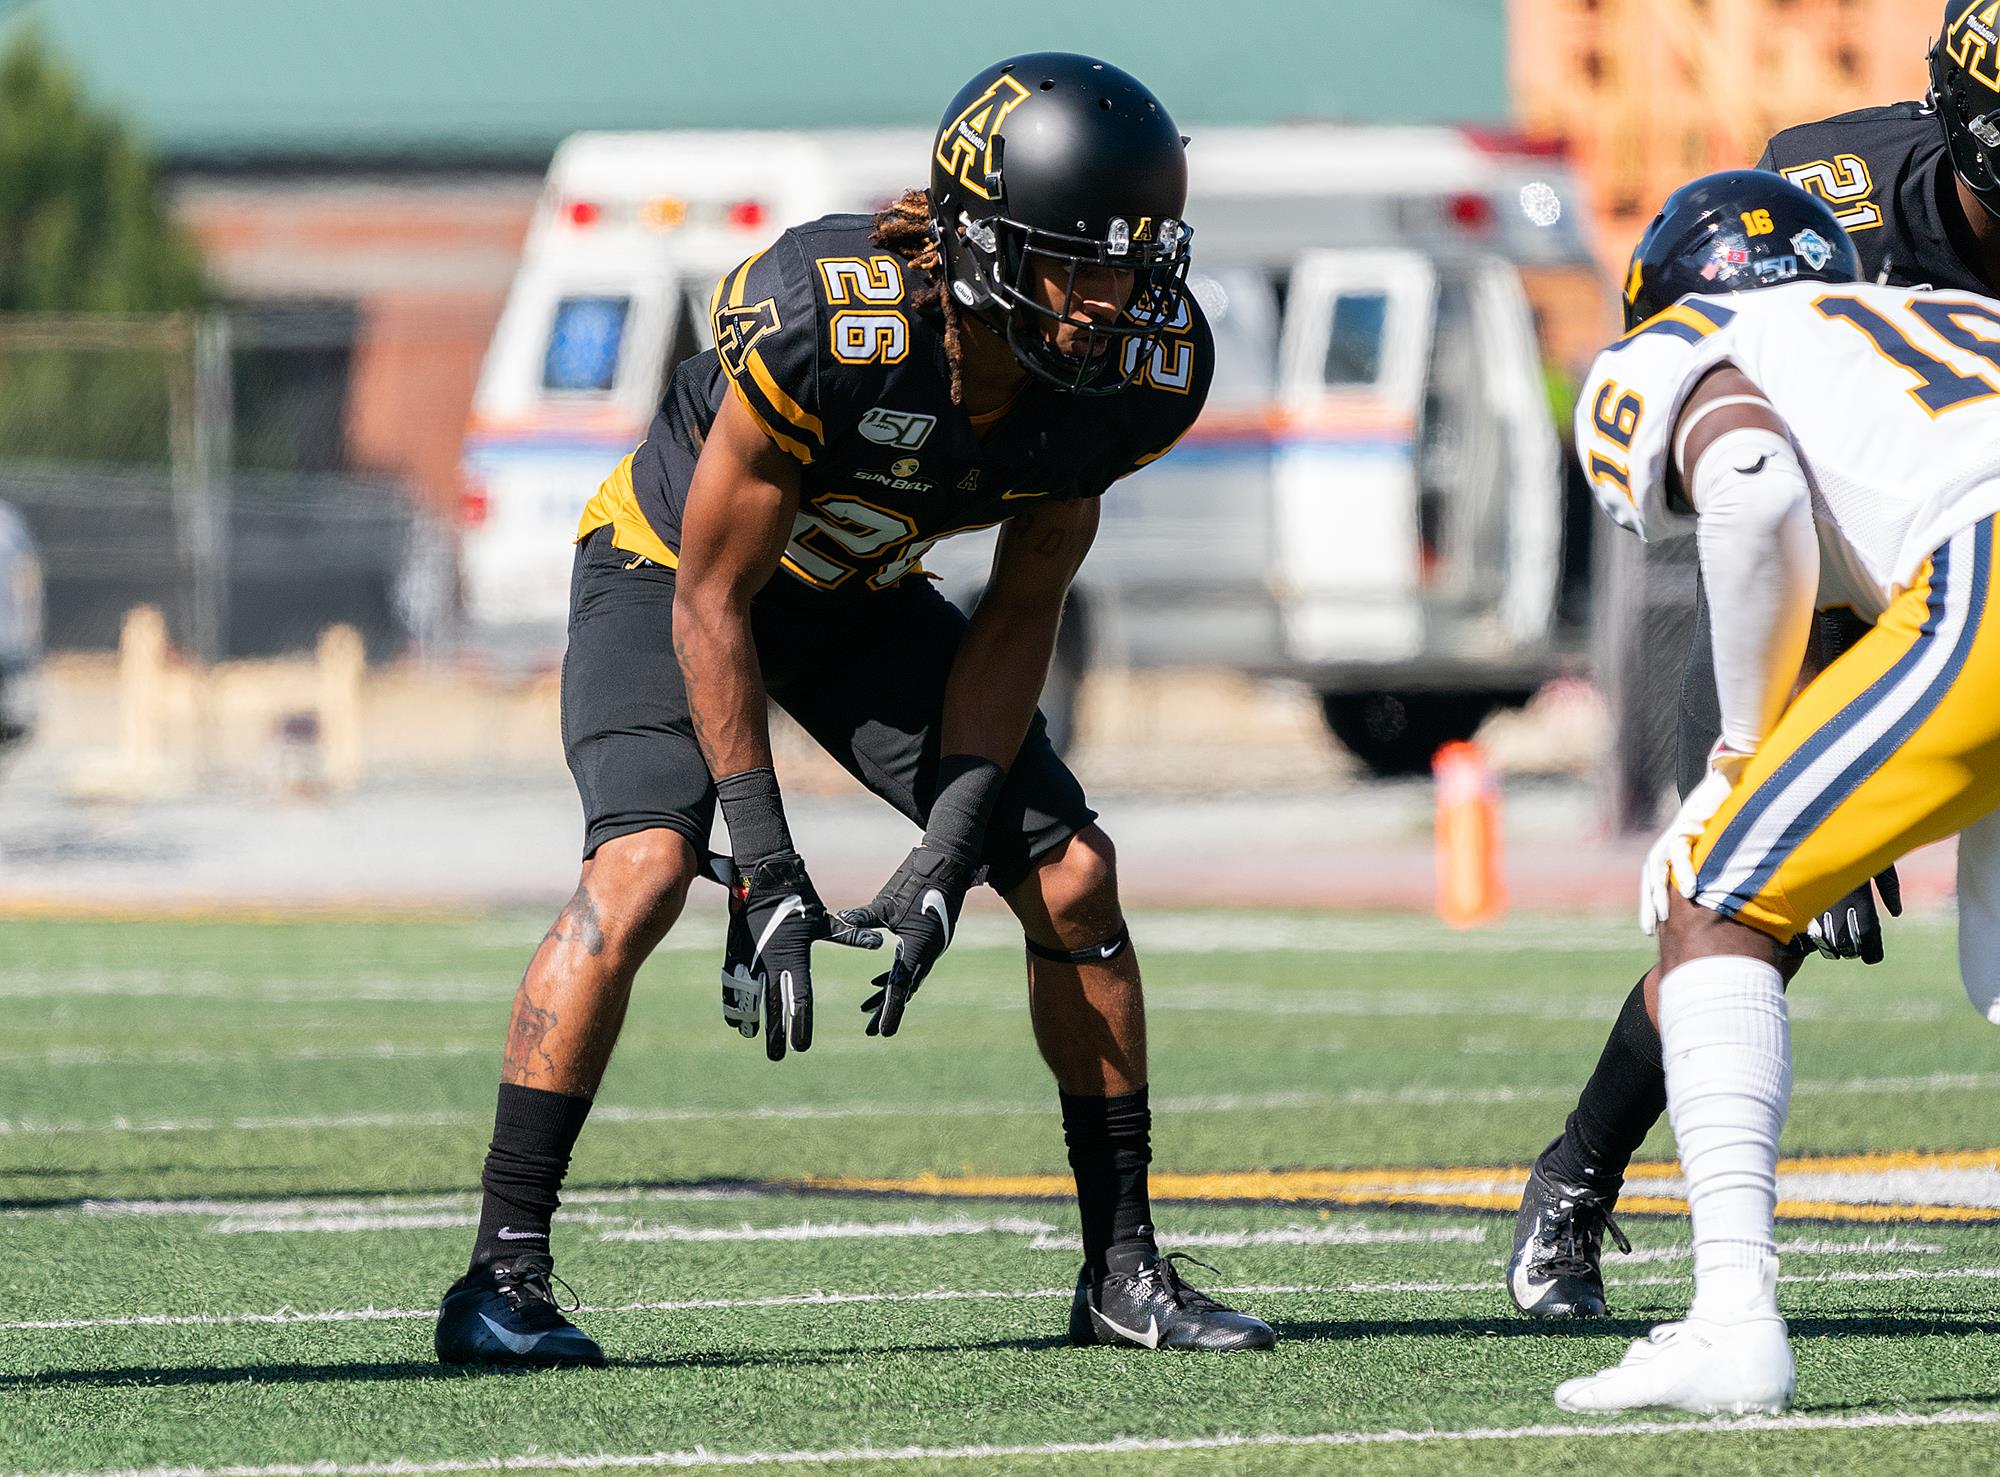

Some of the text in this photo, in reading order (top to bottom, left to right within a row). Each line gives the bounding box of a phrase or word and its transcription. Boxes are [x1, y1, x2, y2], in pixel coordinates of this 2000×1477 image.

[936, 74, 1031, 200] A
[1740, 208, 1775, 238] 16
[1780, 153, 1884, 234] 21
[1132, 217, 1152, 241] A
[714, 297, 783, 377] A
[816, 255, 910, 365] 26
[858, 407, 937, 450] 150
[1588, 378, 1645, 507] 16
[852, 471, 933, 492] SUN BELT
[957, 468, 981, 490] A
